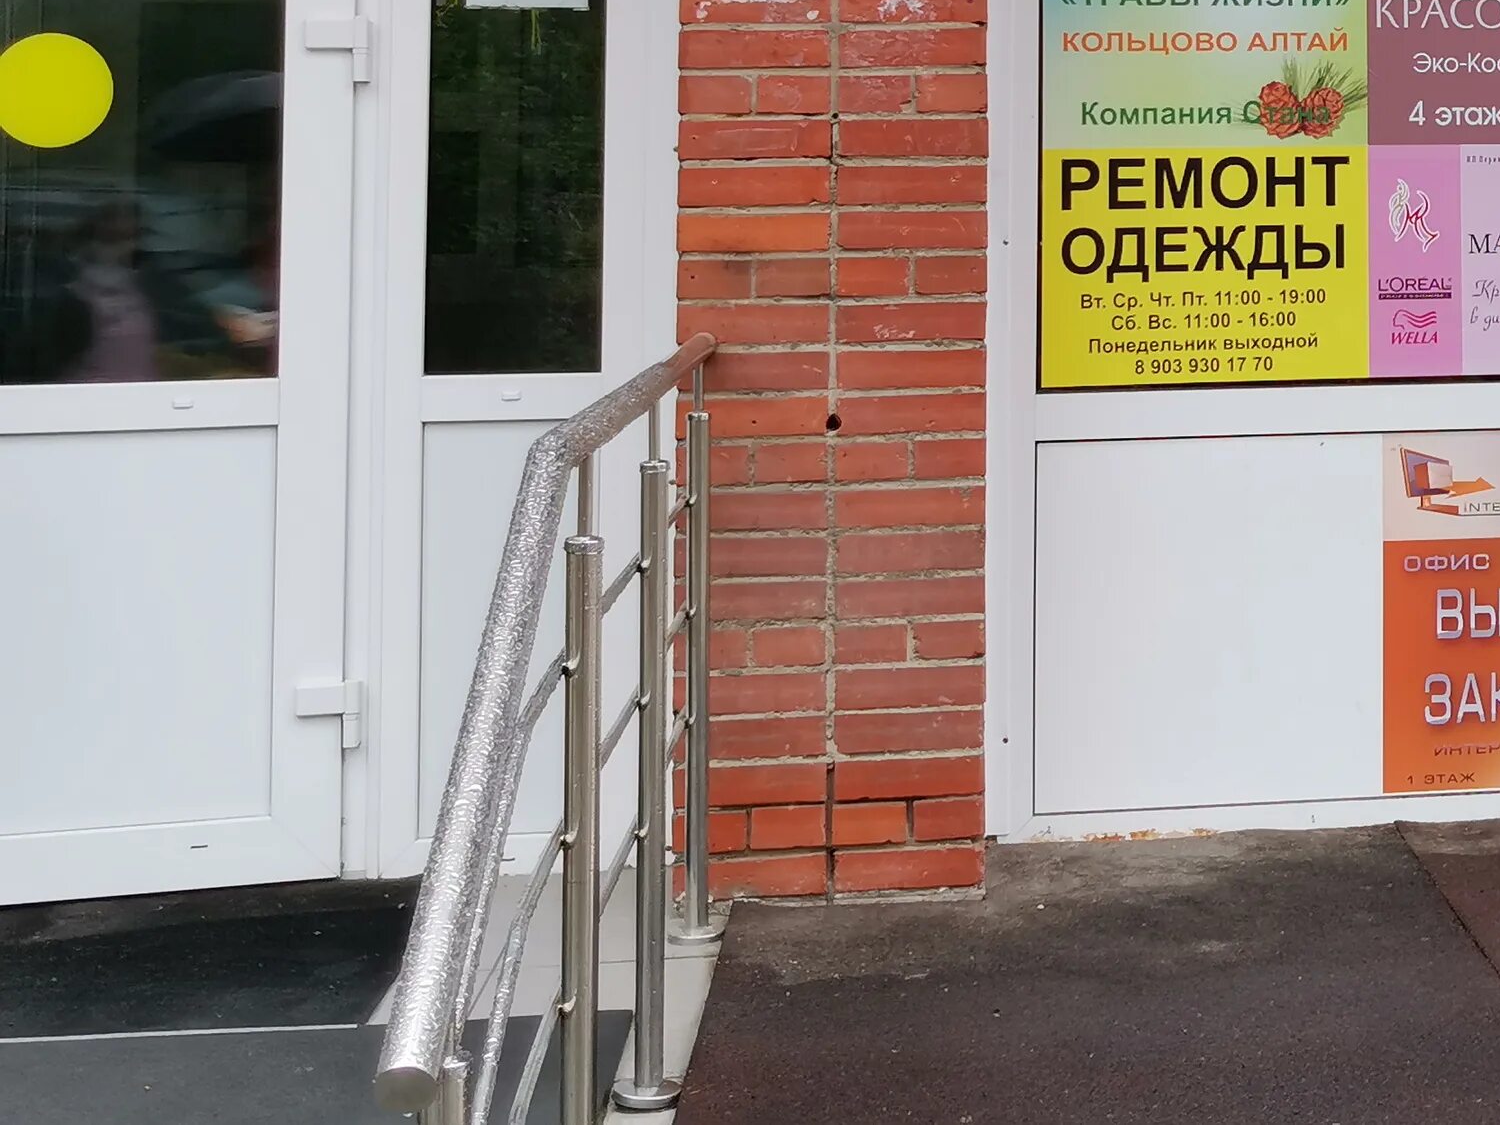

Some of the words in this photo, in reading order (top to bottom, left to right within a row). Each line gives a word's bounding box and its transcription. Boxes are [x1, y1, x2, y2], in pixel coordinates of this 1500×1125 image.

[1062, 32, 1237, 55] КОЛЬЦОВО
[1247, 27, 1348, 52] АЛТАЙ
[1081, 101, 1232, 125] Компания
[1409, 100, 1425, 126] 4
[1061, 155, 1350, 211] РЕМОНТ
[1061, 224, 1344, 284] ОДЕЖДЫ
[1081, 294, 1106, 309] Вт.
[1113, 293, 1143, 311] Ср.
[1150, 292, 1175, 307] Чт.
[1182, 291, 1208, 307] Пт.
[1214, 290, 1261, 306] 11:00
[1280, 289, 1326, 305] 19:00
[1111, 315, 1141, 331] Сб.
[1148, 314, 1177, 330] Вс.
[1184, 313, 1231, 329] 11:00
[1249, 312, 1296, 328] 16:00
[1089, 338, 1217, 355] Понедельник
[1223, 333, 1319, 350] выходной
[1392, 331, 1438, 345] WELLA
[1135, 360, 1144, 375] 8
[1151, 359, 1182, 374] 903
[1189, 358, 1220, 373] 930
[1227, 358, 1245, 372] 17
[1254, 357, 1273, 371] 70
[1404, 553, 1490, 573] ОФИС
[1407, 776, 1414, 784] 1
[1425, 772, 1475, 784] ЭТАЖ
